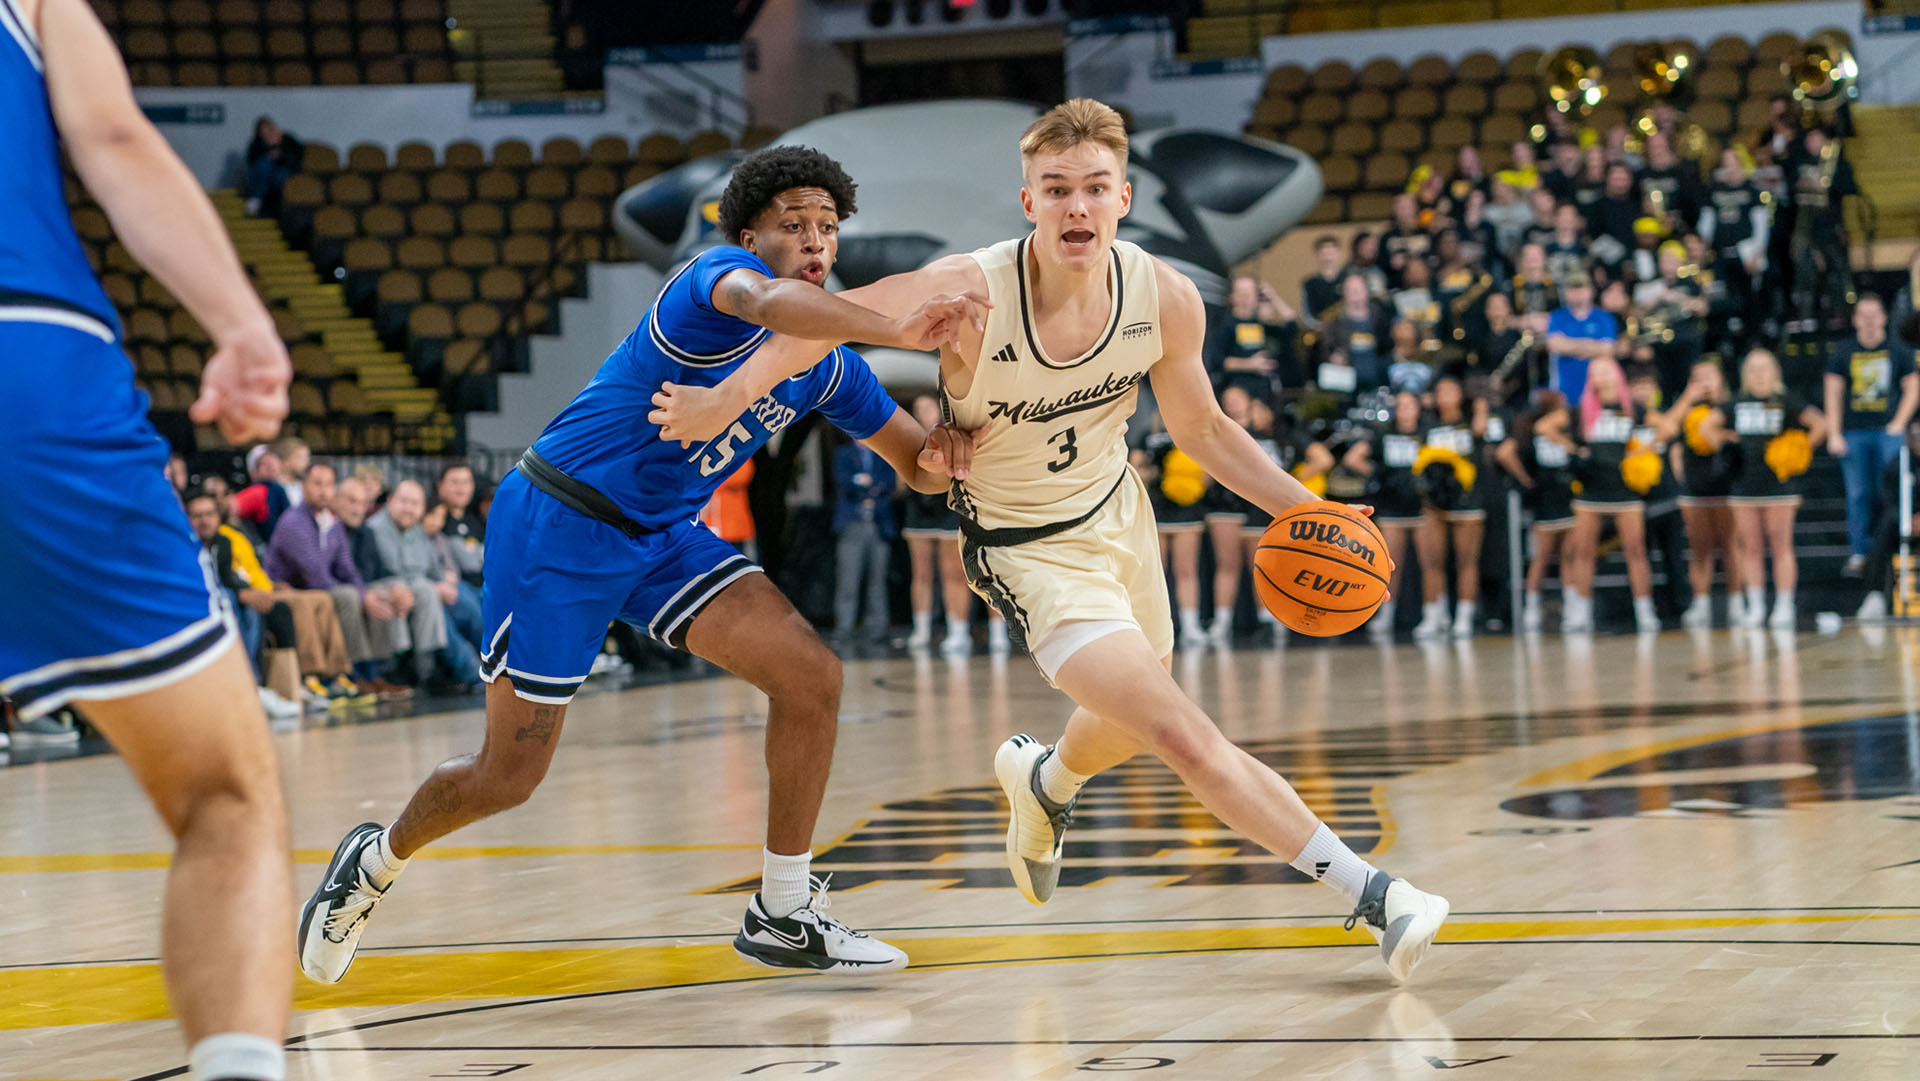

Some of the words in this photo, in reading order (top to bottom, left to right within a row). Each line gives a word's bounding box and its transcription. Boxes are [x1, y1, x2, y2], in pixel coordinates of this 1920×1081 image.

[1122, 325, 1153, 337] HORIZON
[987, 371, 1146, 425] Milwaukee
[1047, 425, 1078, 474] 3
[1289, 520, 1376, 567] Wilson
[1293, 569, 1351, 597] EVO
[1350, 583, 1367, 592] NXT
